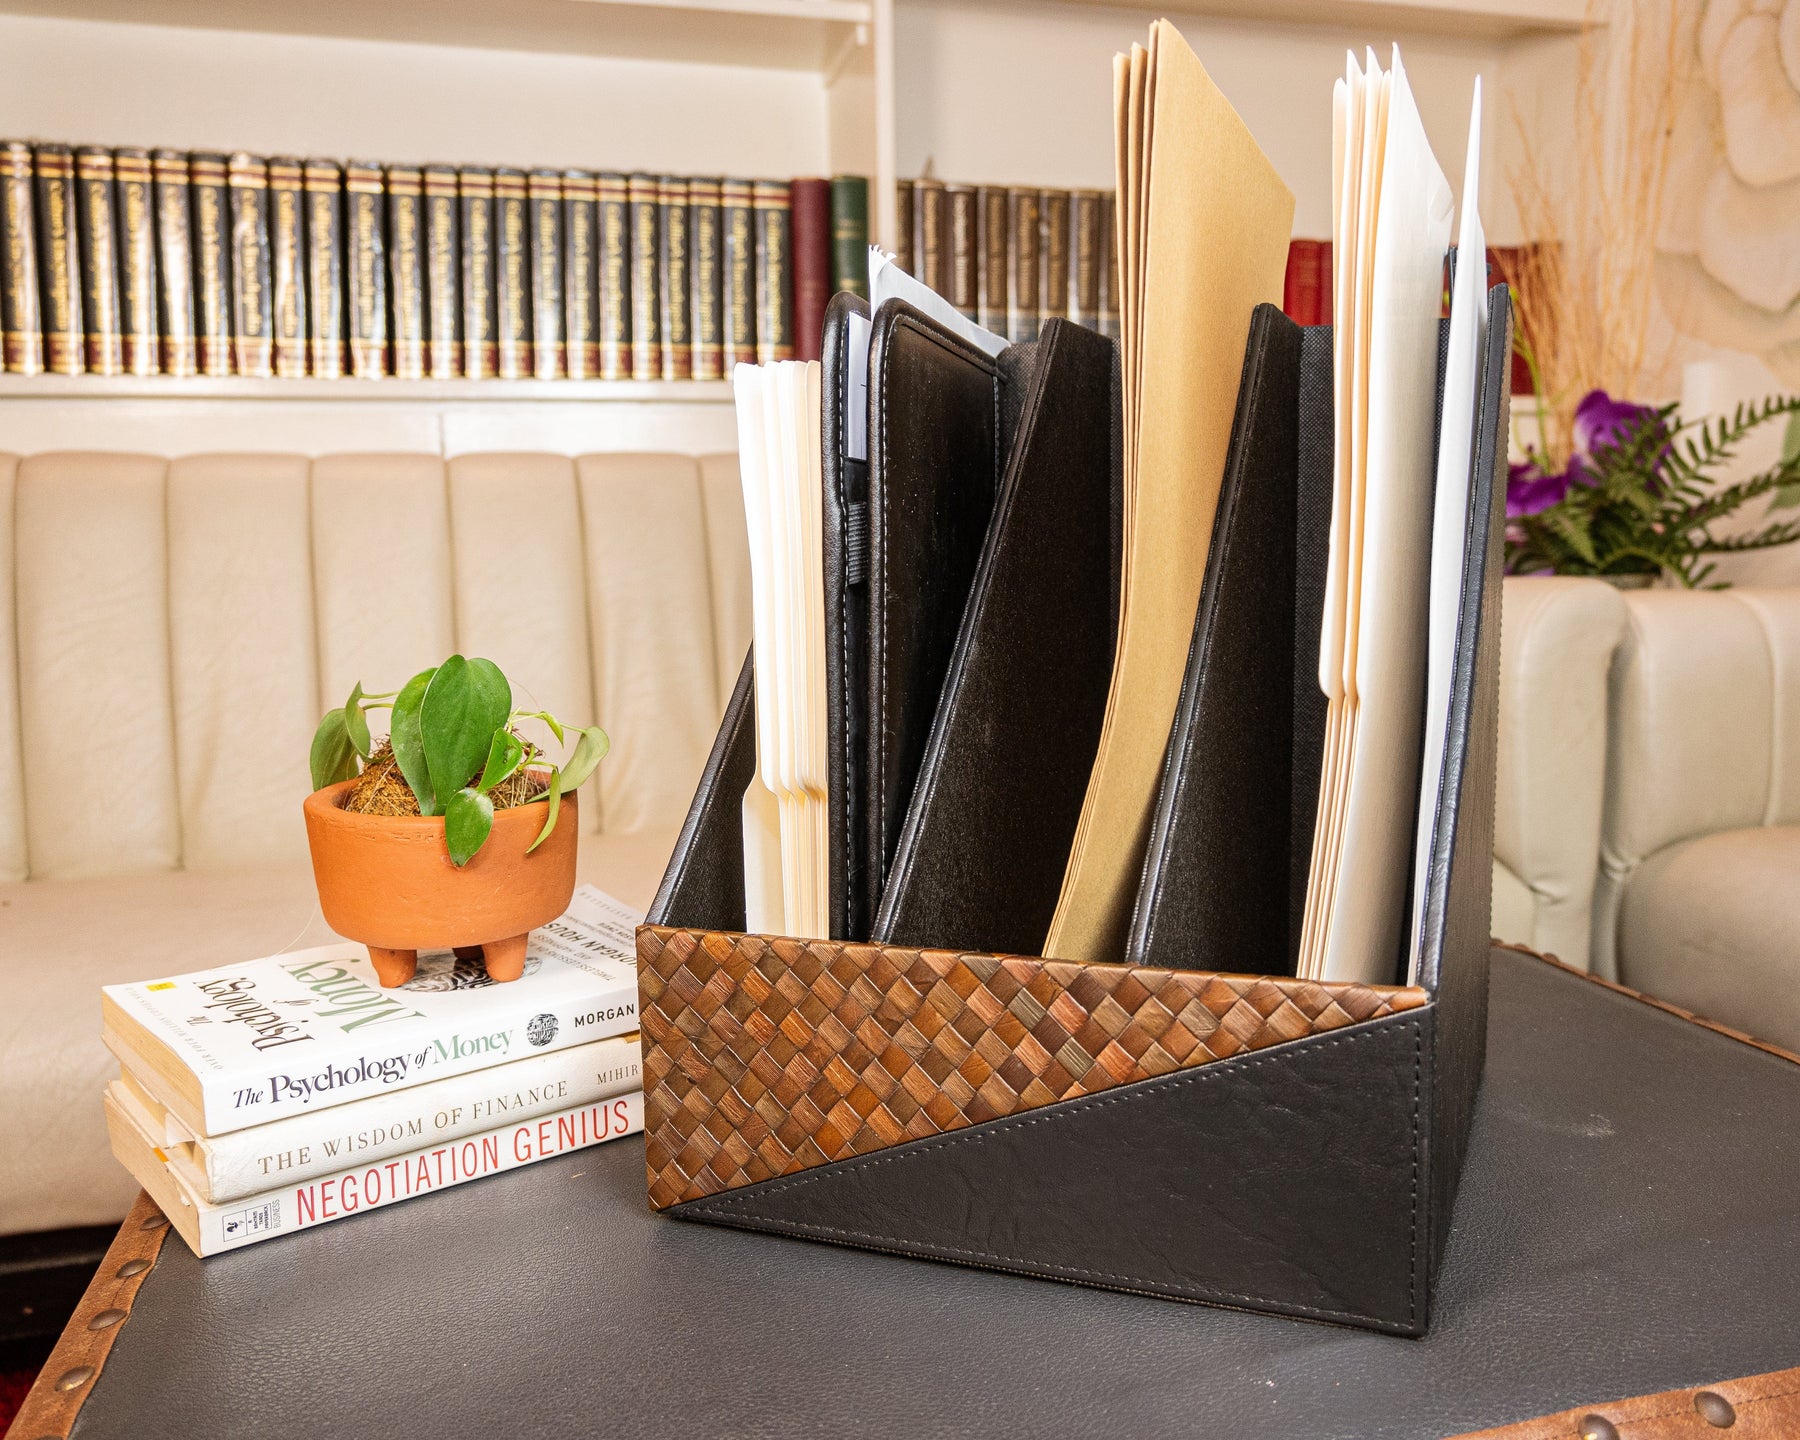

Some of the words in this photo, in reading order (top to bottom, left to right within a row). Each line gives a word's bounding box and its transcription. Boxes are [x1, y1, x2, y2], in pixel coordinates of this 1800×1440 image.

[193, 977, 315, 1052] Psychology
[279, 958, 427, 1034] Money
[232, 1087, 263, 1108] The
[267, 1053, 412, 1104] Psychology
[414, 1045, 432, 1070] of
[432, 1028, 514, 1065] Money
[573, 1003, 636, 1028] MORGAN
[257, 1145, 312, 1176] THE
[322, 1117, 423, 1158] WISDOM
[434, 1107, 463, 1130] OF
[471, 1079, 569, 1120] FINANCE
[596, 1064, 640, 1086] MIHIR
[296, 1134, 499, 1226] NEGOTIATION
[512, 1099, 630, 1163] GENIUS
